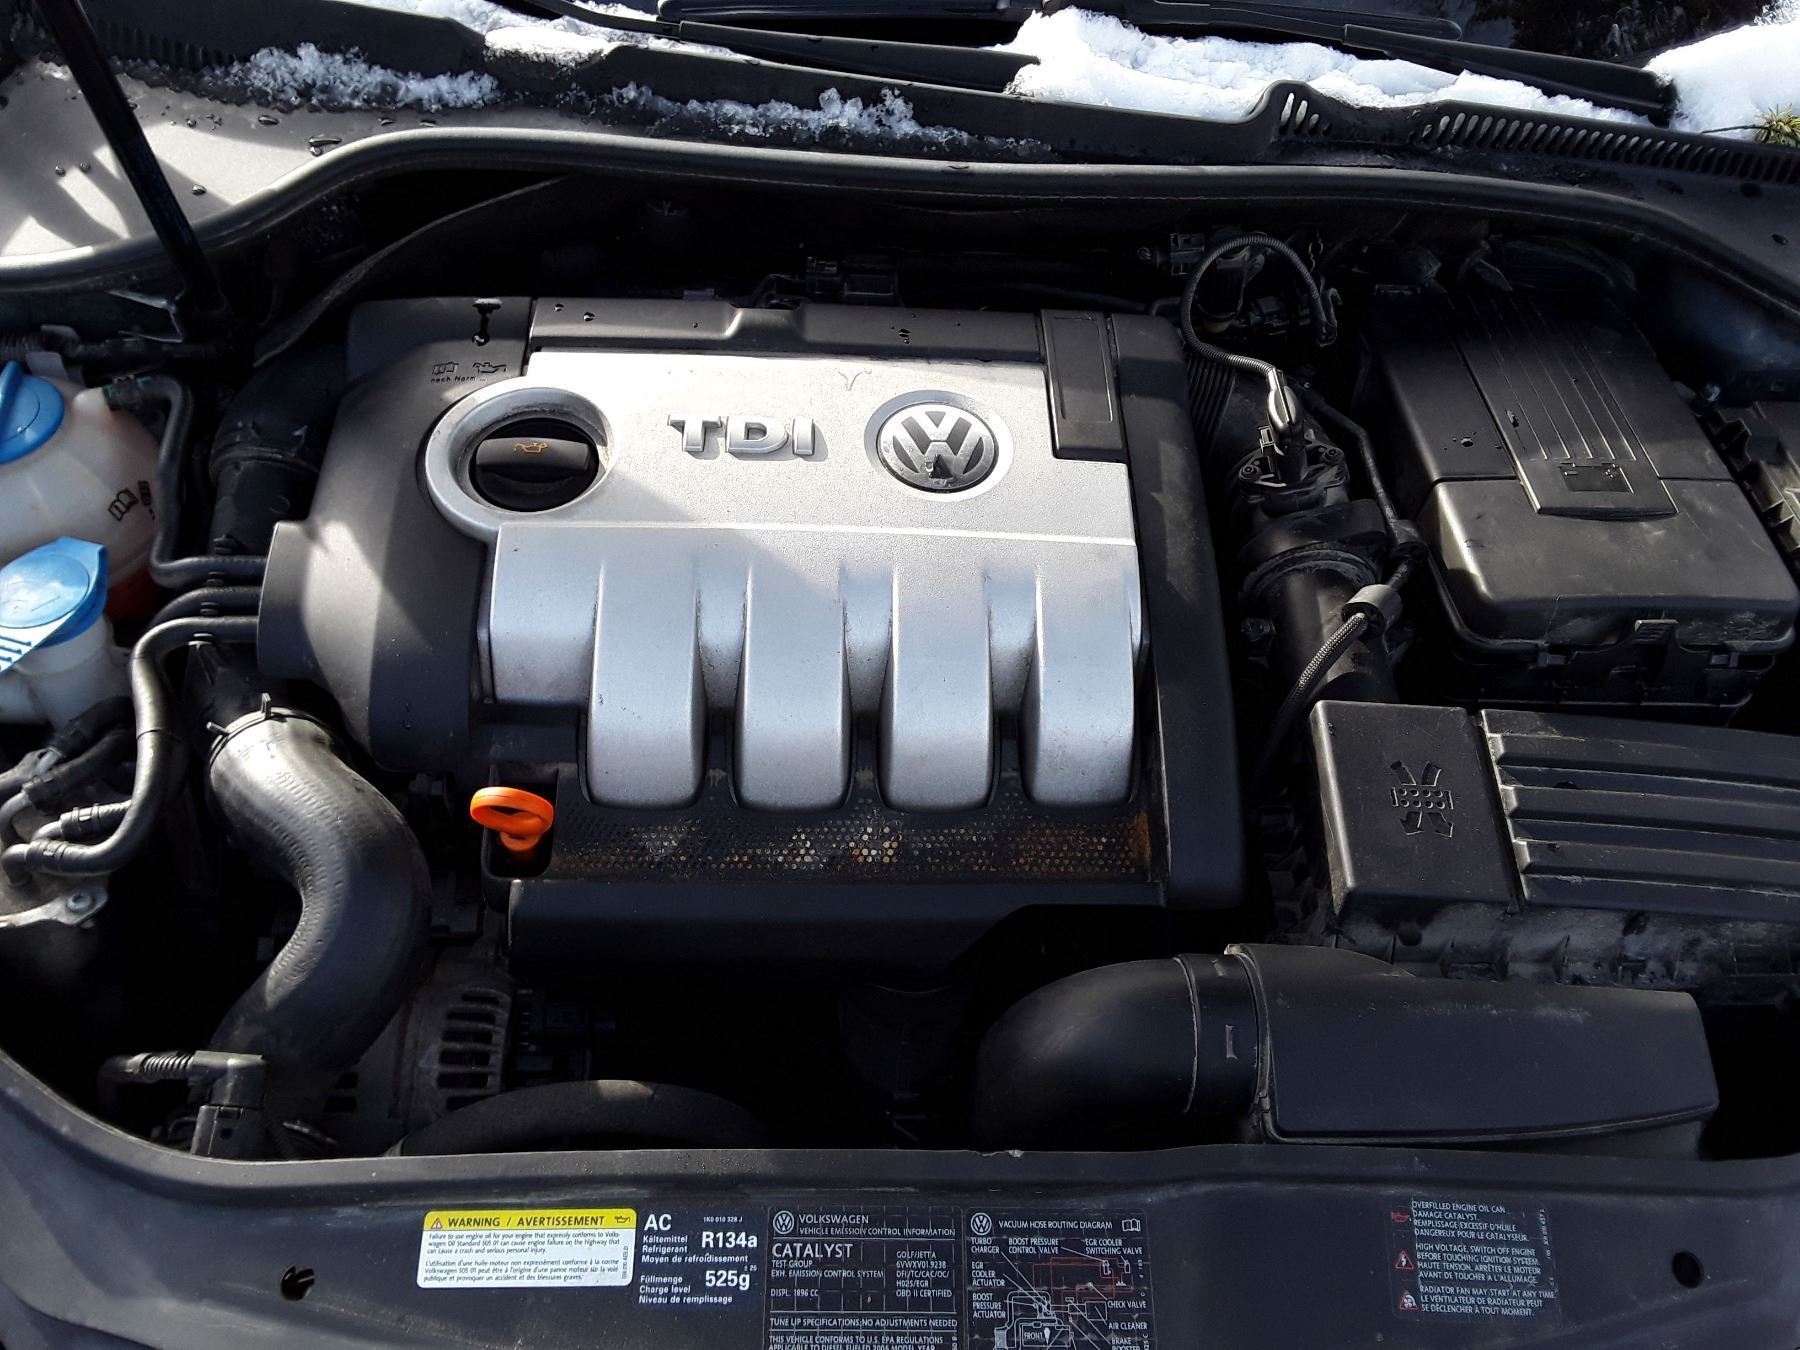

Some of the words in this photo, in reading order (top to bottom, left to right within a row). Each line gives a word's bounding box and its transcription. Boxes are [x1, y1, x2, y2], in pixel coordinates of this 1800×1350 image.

[667, 414, 816, 455] TDI
[876, 400, 999, 493] VW
[1412, 1201, 1450, 1209] OVERFILLED
[1413, 1210, 1442, 1218] DAMAGE
[448, 1217, 500, 1227] WARNING
[506, 1217, 512, 1227] /
[517, 1216, 605, 1226] AVERTISSEMENT
[644, 1214, 672, 1231] AC
[772, 1210, 795, 1234] VW
[799, 1214, 868, 1224] VOLKSWAGEN
[971, 1212, 992, 1235] VW
[999, 1220, 1028, 1228] VACUUM
[1030, 1220, 1047, 1228] HOSE
[1048, 1220, 1079, 1228] ROUTING
[1080, 1221, 1113, 1229] DIAGRAM
[903, 1228, 955, 1236] INFORMATION
[643, 1235, 688, 1243] Kältemittel
[701, 1231, 758, 1248] R134a
[971, 1237, 992, 1245] TURBO
[1085, 1238, 1097, 1246] EGR
[1099, 1238, 1122, 1246] COOLER
[642, 1245, 688, 1254] Refrigerant
[772, 1243, 853, 1258] CATALYST
[1008, 1246, 1037, 1254] CONTROL
[1038, 1246, 1058, 1254] VALVE
[1416, 1243, 1433, 1251] HIGH
[1470, 1246, 1496, 1254] SWITCH
[1512, 1248, 1535, 1256] ENGINE
[641, 1255, 669, 1264] Moyen
[685, 1254, 748, 1263] refroidissement
[772, 1260, 786, 1268] TEST
[789, 1260, 812, 1268] GROUP
[972, 1270, 996, 1278] COOLER
[640, 1275, 683, 1284] Füllmenge
[705, 1270, 750, 1290] 525g
[639, 1285, 668, 1294] Charge
[671, 1285, 691, 1293] level
[896, 1289, 911, 1297] OBD
[920, 1289, 952, 1297] CERTIFIED
[1420, 1285, 1454, 1294] RADIATOR
[639, 1295, 668, 1304] Niveau
[670, 1295, 680, 1303] de
[683, 1295, 733, 1304] remplissage
[1108, 1300, 1126, 1308] CHECK
[1127, 1300, 1146, 1308] VALVE
[1430, 1295, 1475, 1304] VENTILATEUR
[1477, 1297, 1486, 1305] DE
[1487, 1298, 1526, 1306] RADIATEUR
[770, 1318, 789, 1326] TUNE
[791, 1318, 801, 1326] UP
[929, 1319, 957, 1327] NEEDED
[1109, 1322, 1119, 1330] AIR
[1120, 1322, 1147, 1330] CLEANER
[769, 1336, 784, 1344] THIS
[786, 1336, 813, 1344] VEHICLE
[815, 1336, 853, 1344] CONFORMS
[855, 1336, 865, 1344] TO
[882, 1336, 894, 1344] EPA
[897, 1336, 943, 1344] REGULATIONS
